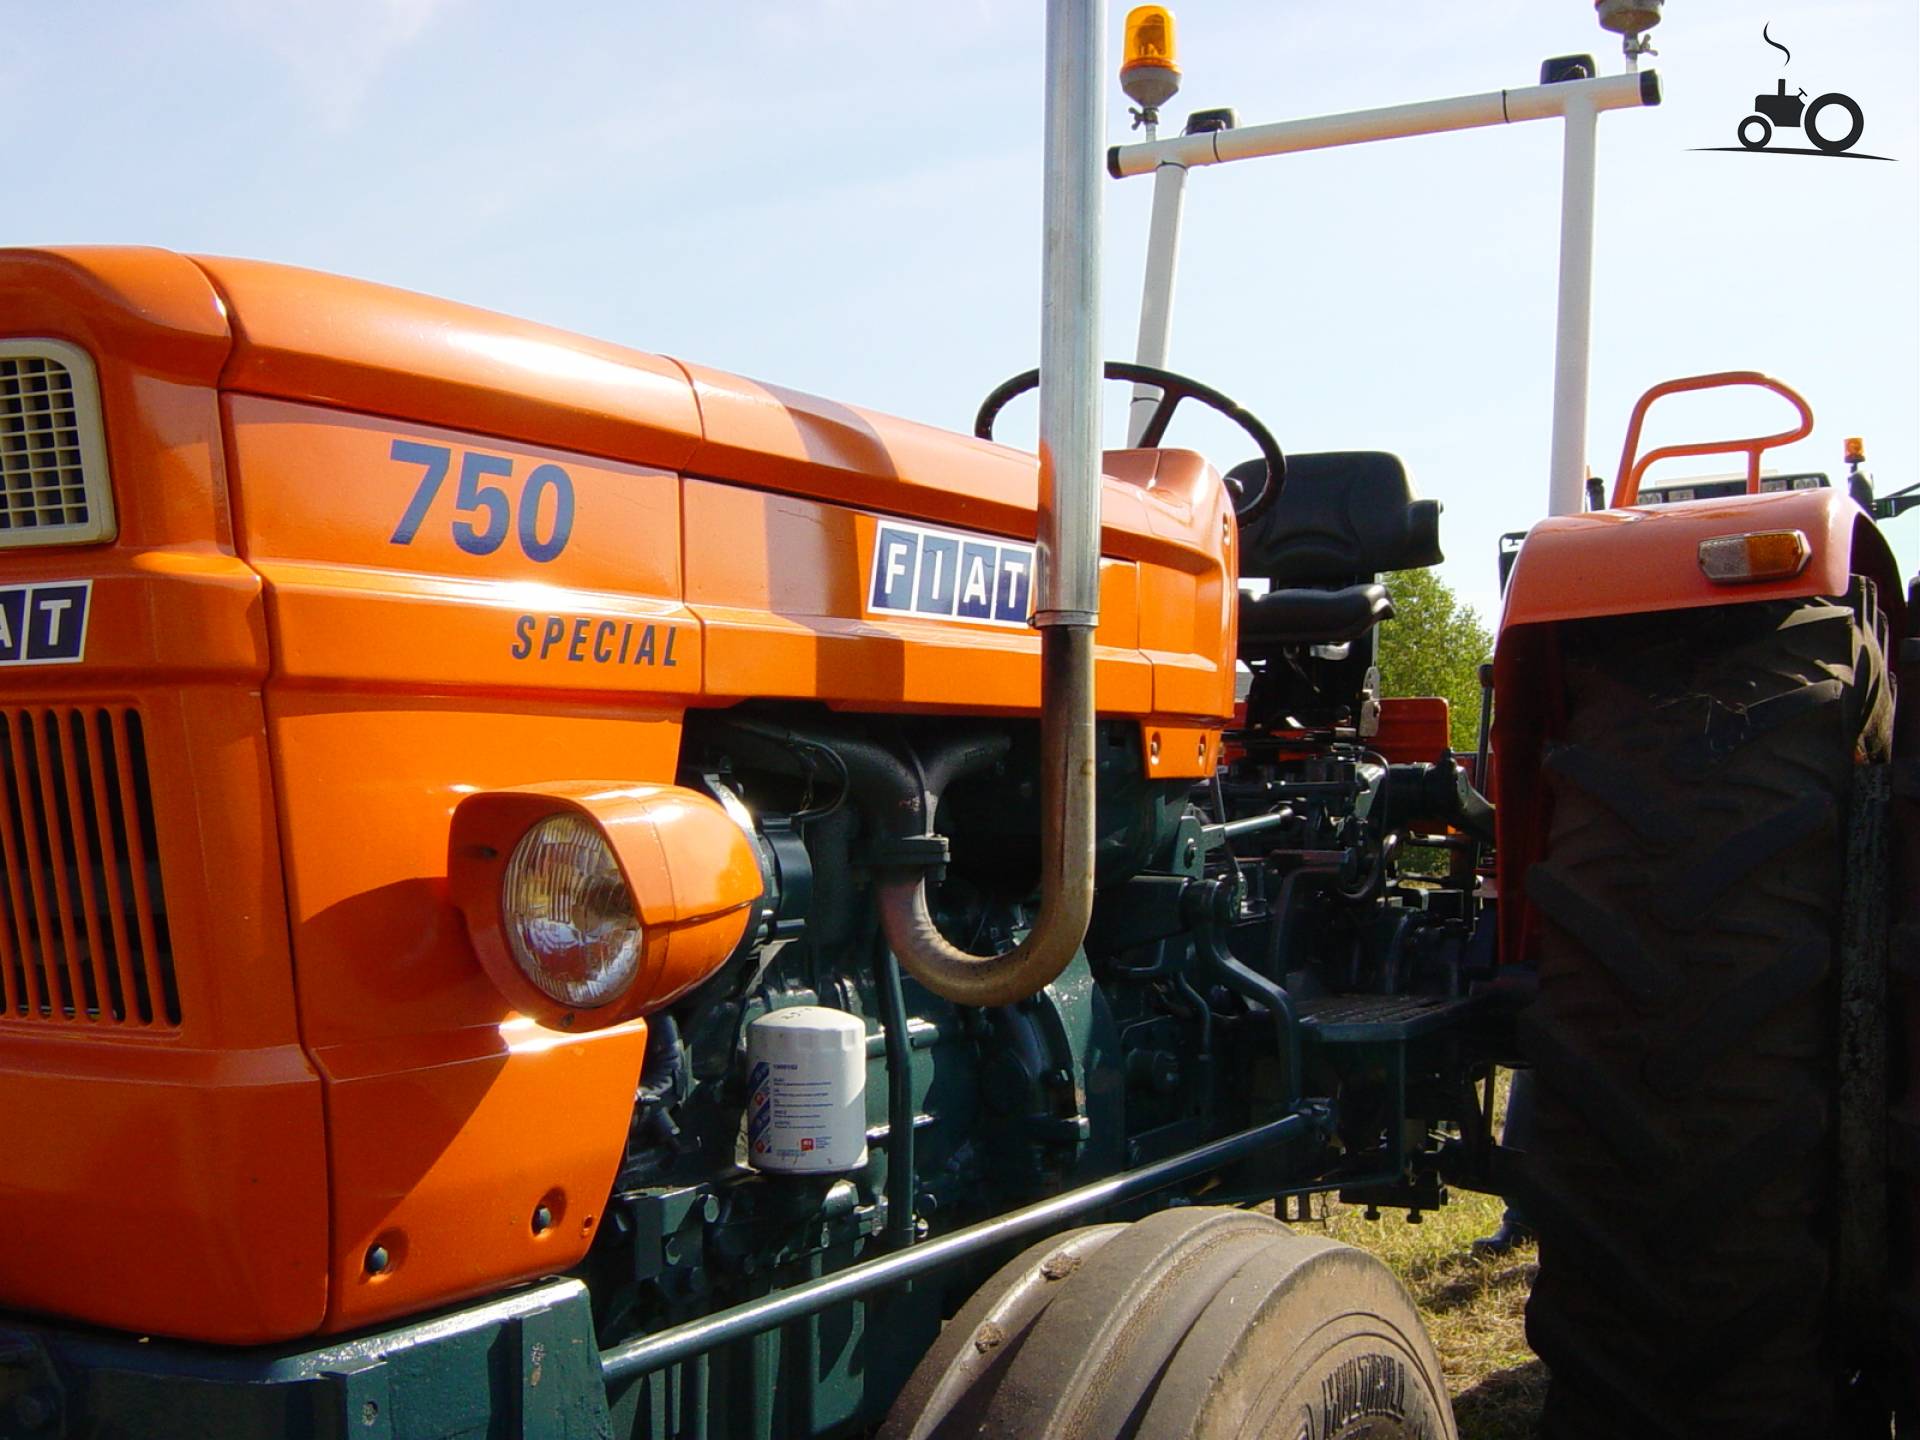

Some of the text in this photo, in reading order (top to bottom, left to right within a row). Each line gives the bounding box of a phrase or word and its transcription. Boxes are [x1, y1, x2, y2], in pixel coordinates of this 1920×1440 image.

[390, 438, 576, 563] 750
[884, 542, 1025, 609] FIAT
[511, 615, 677, 667] SPECIAL
